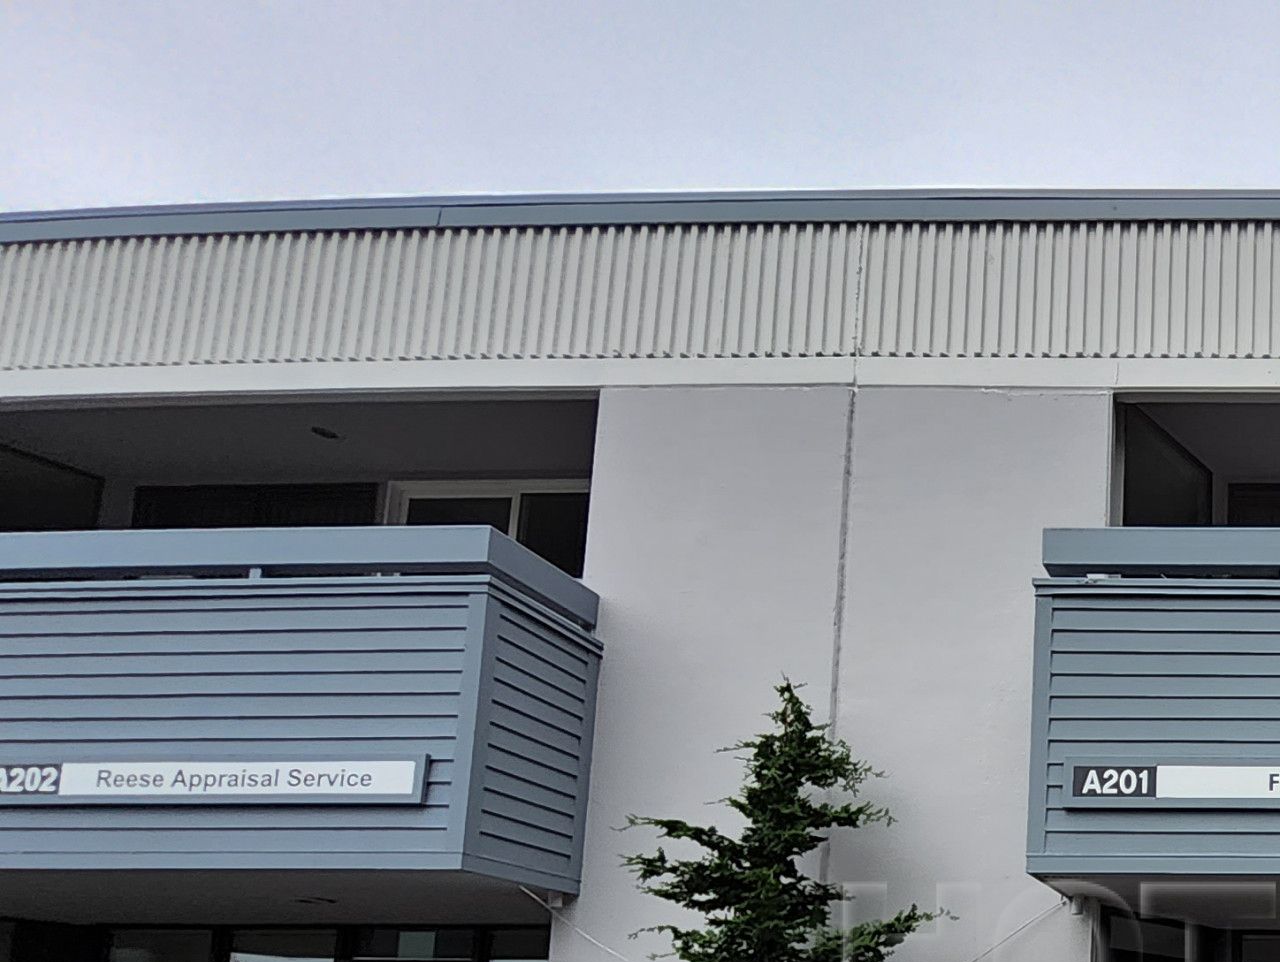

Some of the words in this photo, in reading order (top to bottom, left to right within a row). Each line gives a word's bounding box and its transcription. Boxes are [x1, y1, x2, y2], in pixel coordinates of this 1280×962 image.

[96, 769, 164, 789] Reese
[170, 768, 280, 793] Appraisal
[287, 768, 372, 788] Service
[1081, 768, 1149, 795] A201
